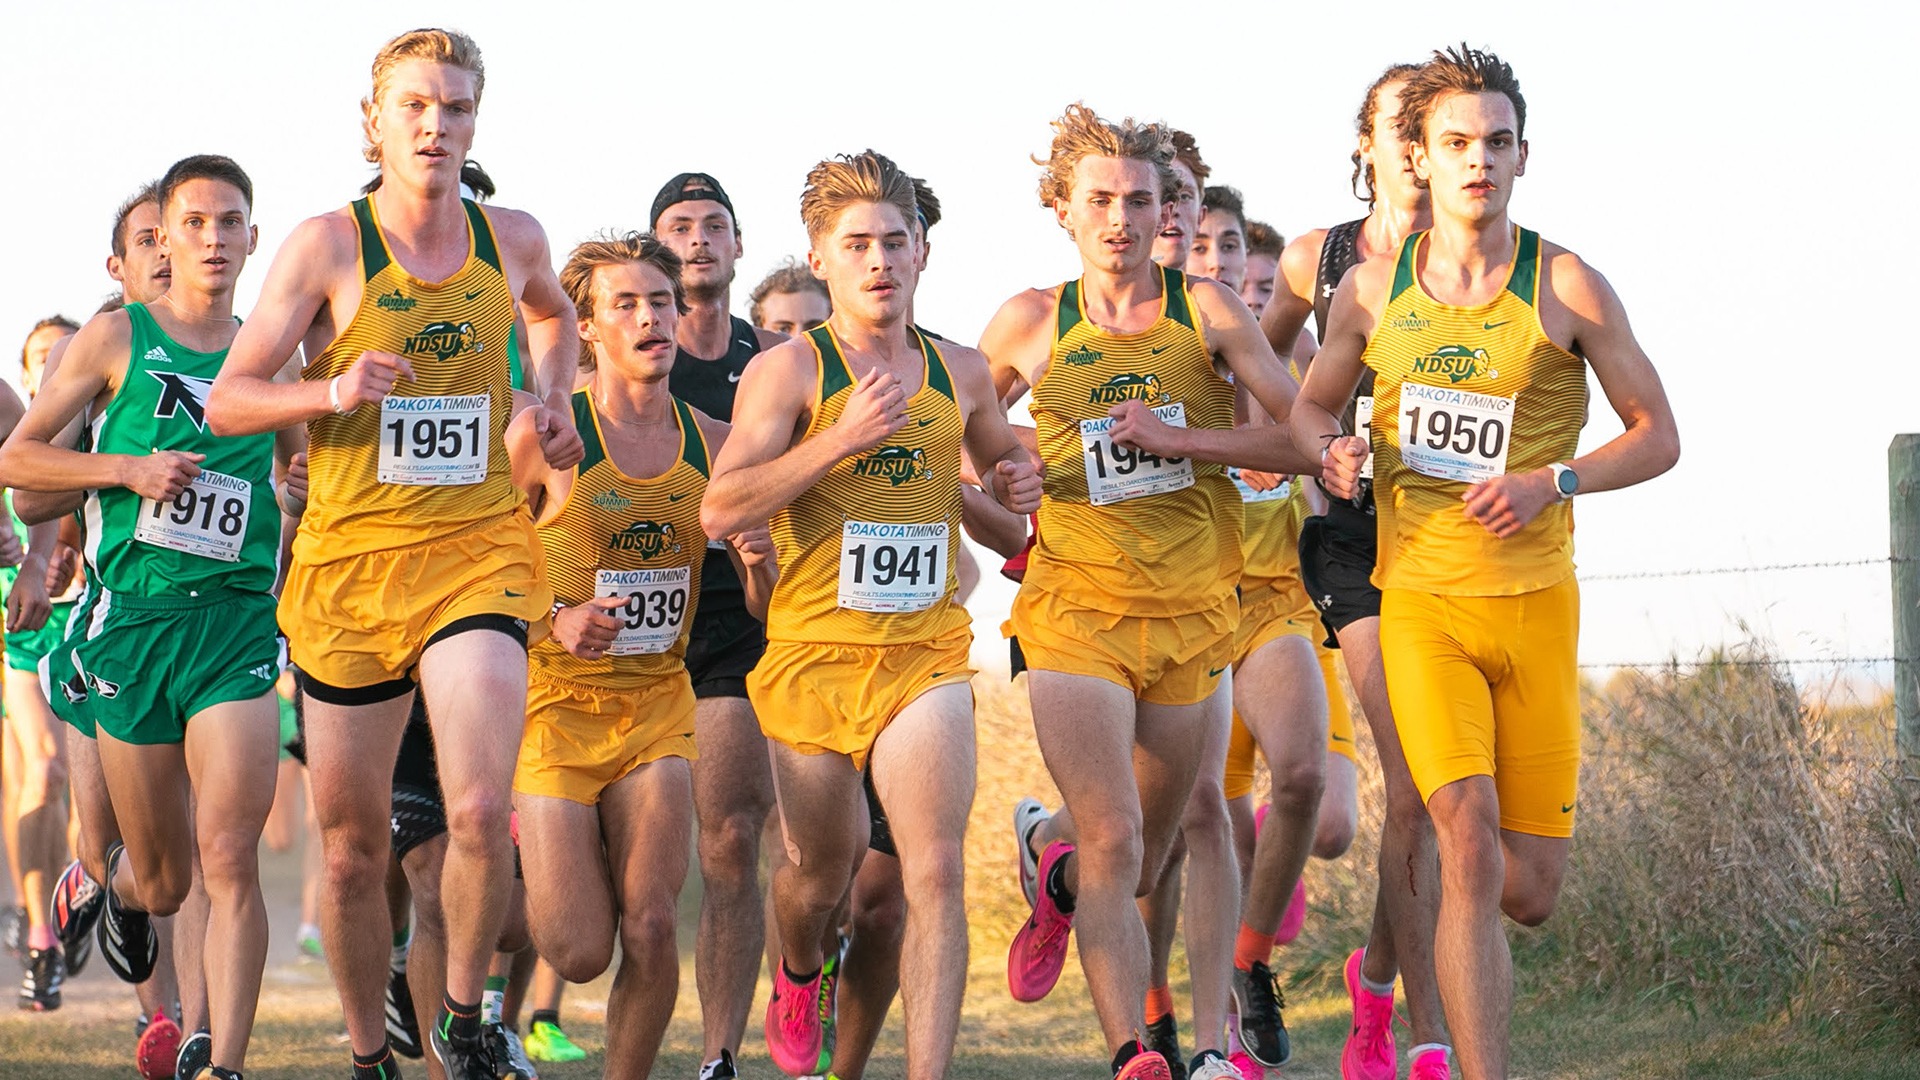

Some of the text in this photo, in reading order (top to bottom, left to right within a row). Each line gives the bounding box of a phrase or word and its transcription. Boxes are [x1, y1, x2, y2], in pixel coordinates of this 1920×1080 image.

[402, 334, 459, 355] NDSU
[1412, 357, 1471, 374] NDSU
[388, 396, 485, 411] DAKOTATIMING
[1088, 384, 1145, 404] NDSU
[1407, 385, 1507, 411] DAKOTATIMING
[387, 417, 480, 459] 1951
[1405, 406, 1505, 459] 1950
[852, 458, 911, 477] NDSU
[850, 523, 944, 538] DAKOTATIMING
[608, 532, 660, 552] NDSU
[848, 544, 938, 586] 1941
[602, 568, 686, 584] DAKOTATIMING
